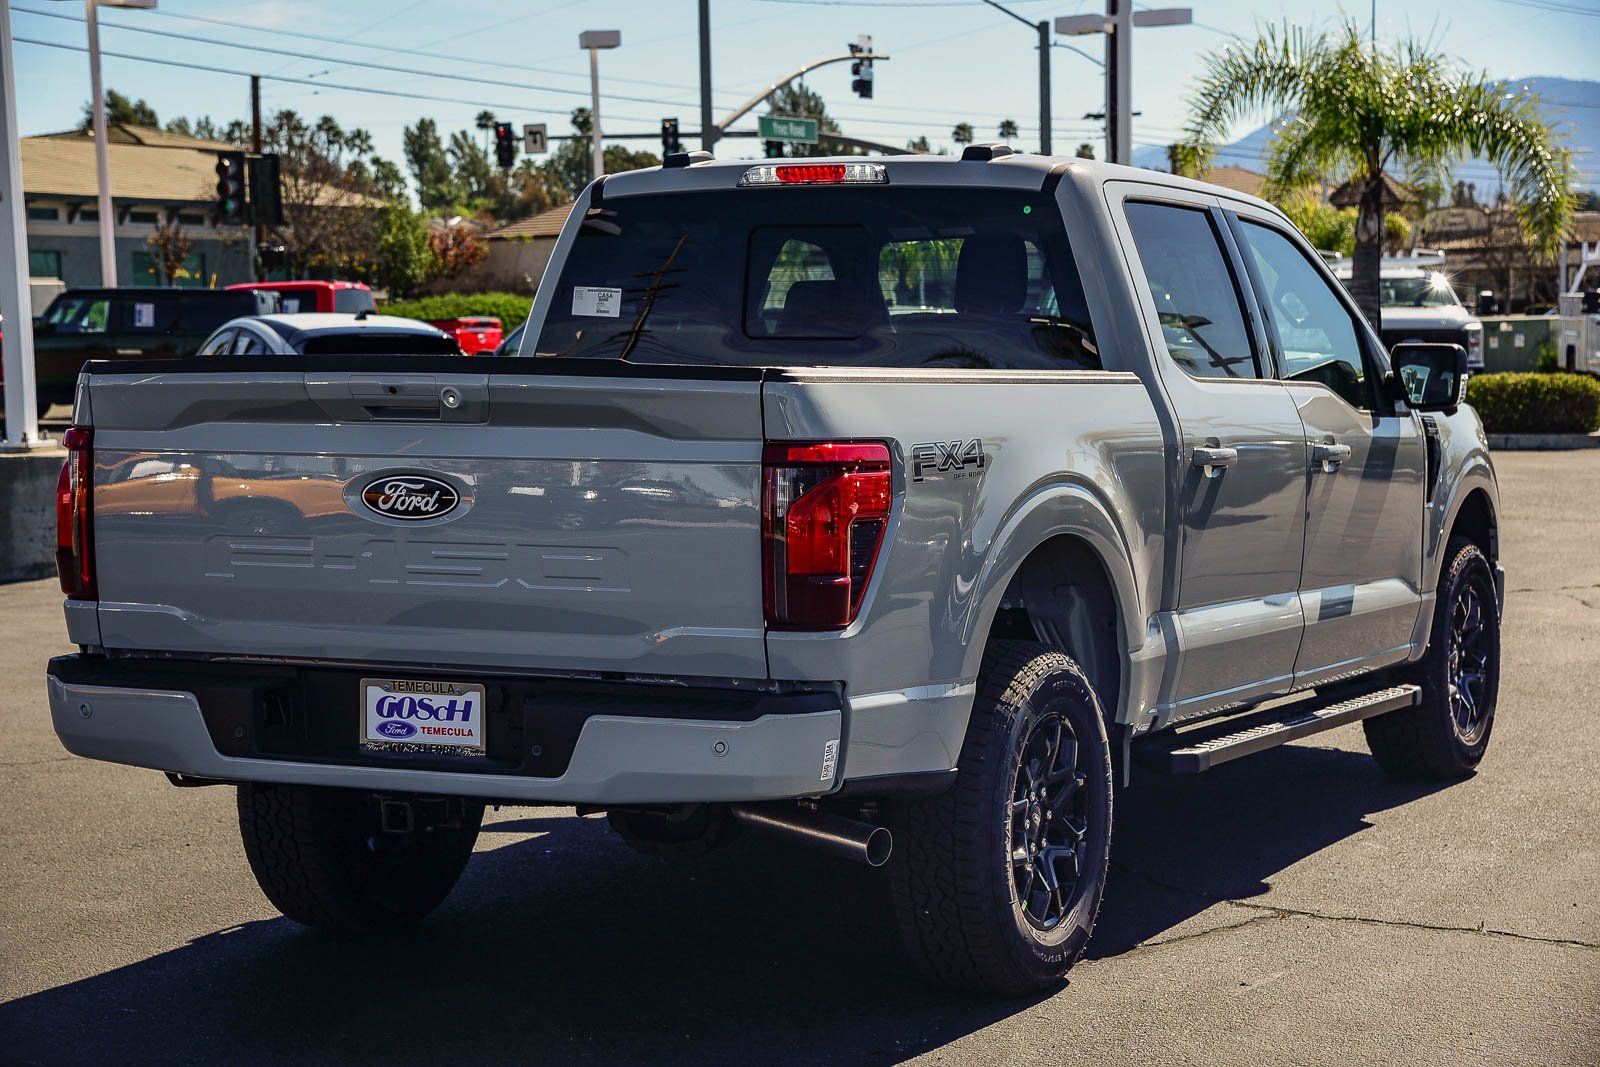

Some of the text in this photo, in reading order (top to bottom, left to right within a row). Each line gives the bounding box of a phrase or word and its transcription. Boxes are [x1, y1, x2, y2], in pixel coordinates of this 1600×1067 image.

[910, 438, 985, 482] FX4
[378, 481, 440, 512] Ford
[391, 680, 455, 694] TEMECULA
[384, 723, 474, 738] Ford TEMECULA
